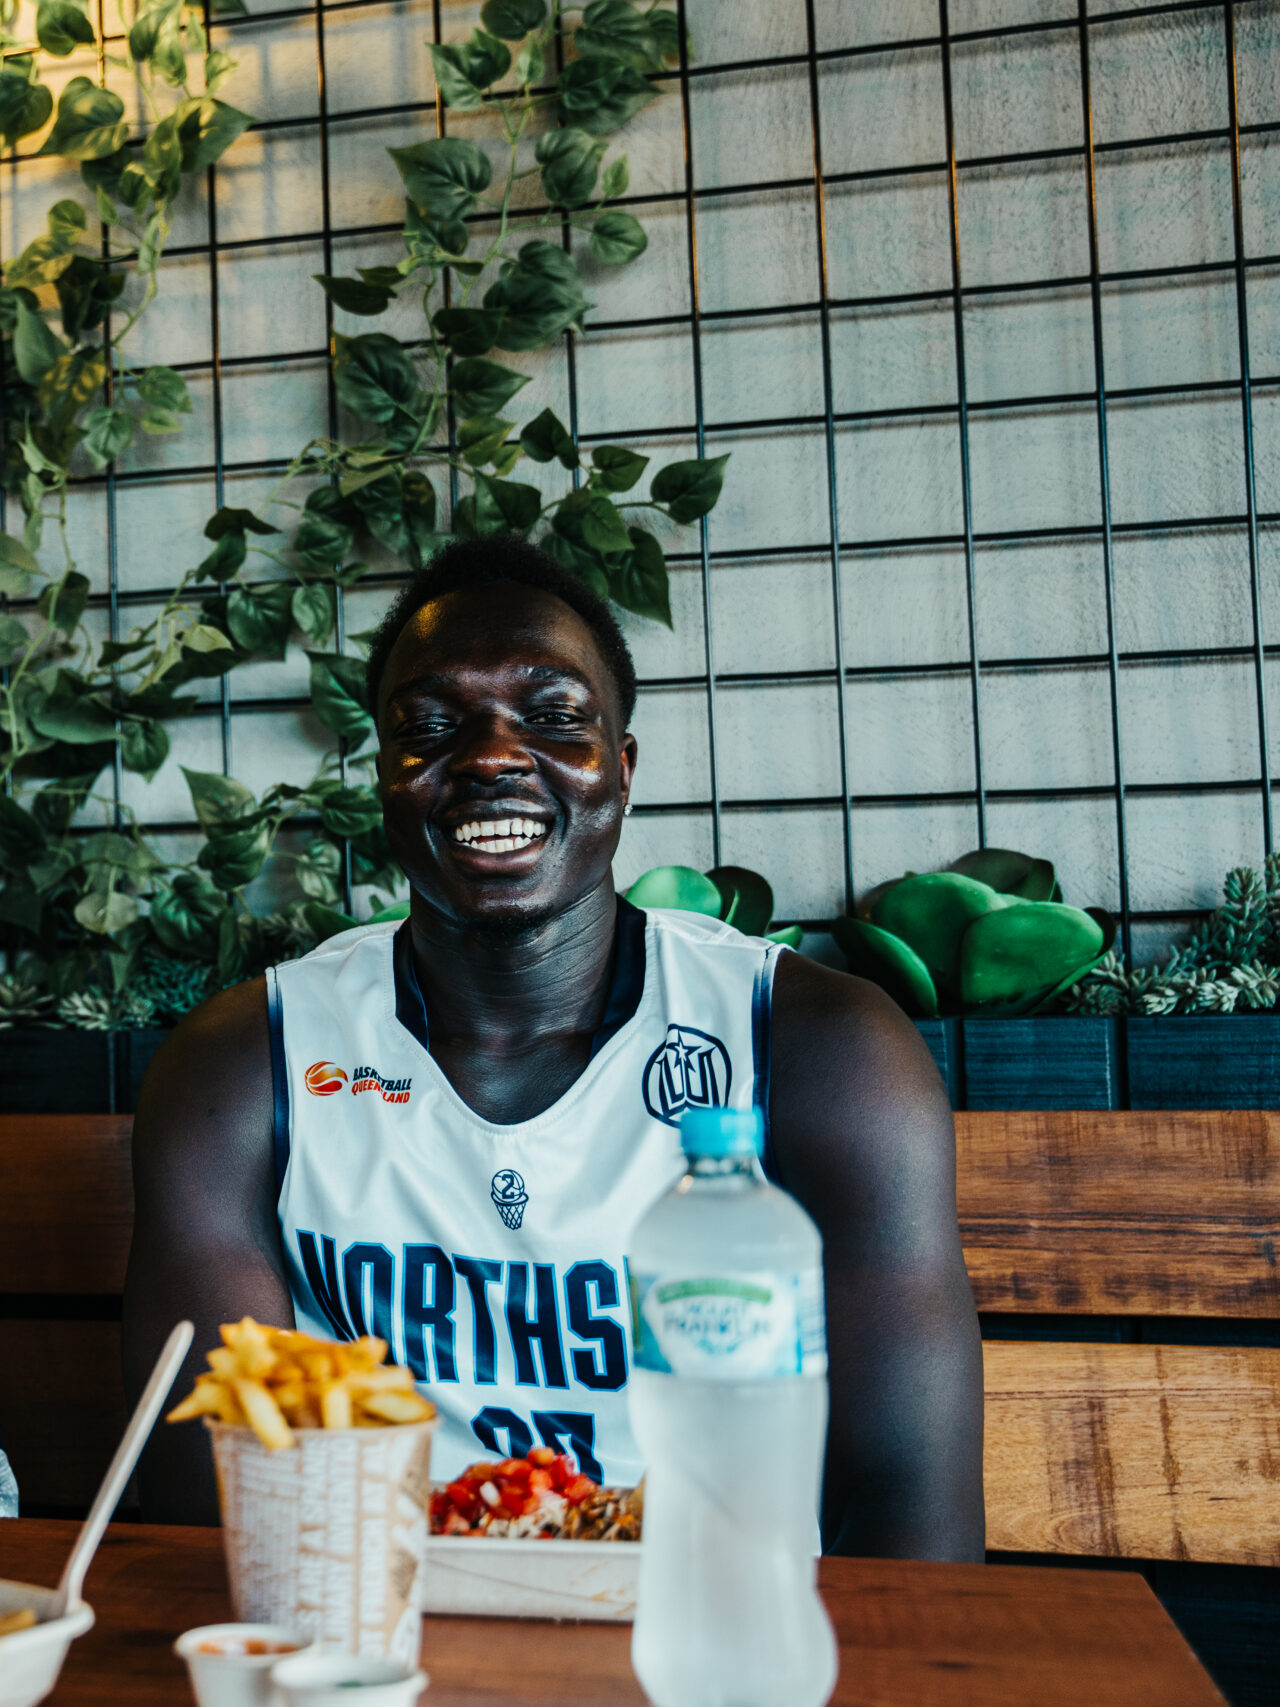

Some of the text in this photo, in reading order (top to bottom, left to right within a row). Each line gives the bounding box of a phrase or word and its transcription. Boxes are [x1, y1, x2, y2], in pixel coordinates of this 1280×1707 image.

[351, 1079, 411, 1104] QUEENLAND
[502, 1173, 516, 1199] 2
[296, 1229, 631, 1391] NORTHS
